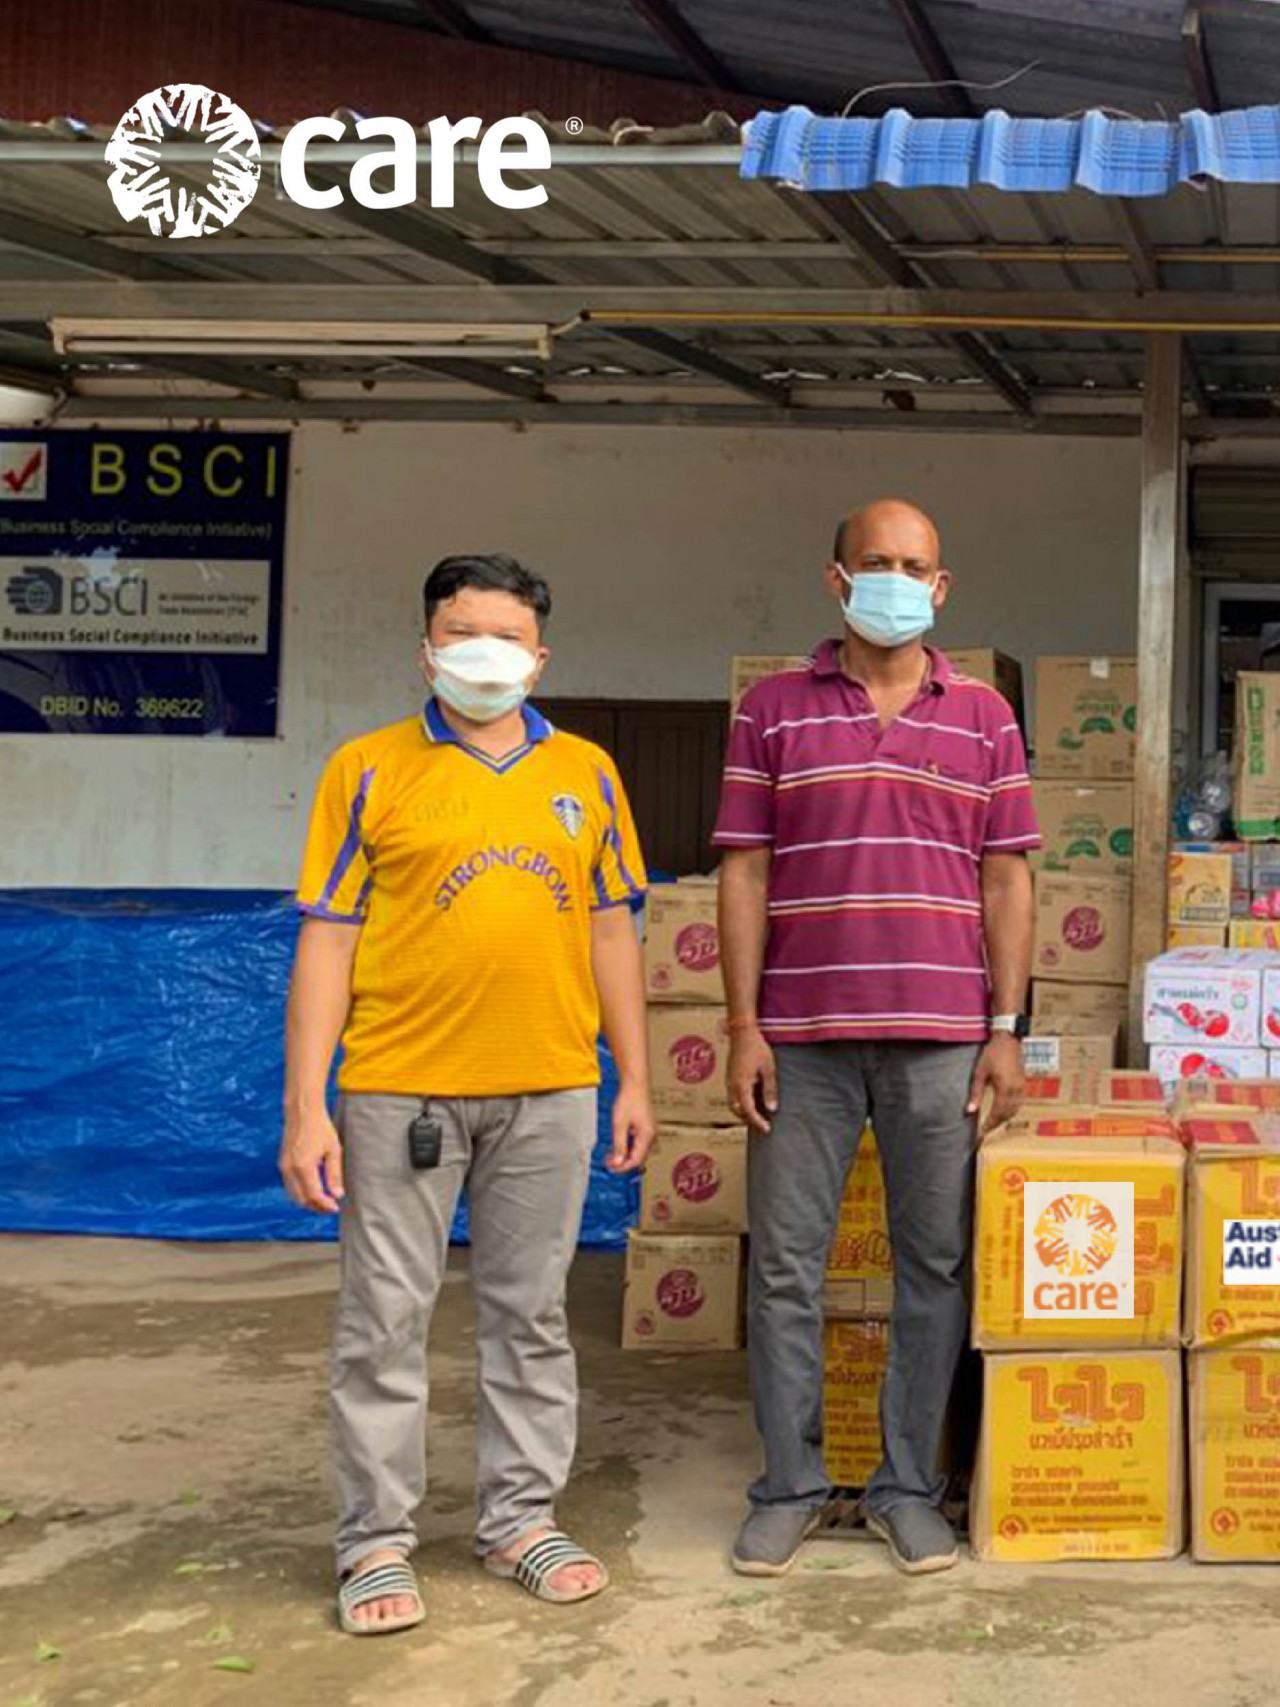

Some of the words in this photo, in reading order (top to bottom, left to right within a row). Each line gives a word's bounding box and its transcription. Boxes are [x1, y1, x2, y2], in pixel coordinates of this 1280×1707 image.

[70, 577, 148, 616] BSCI
[3, 626, 65, 643] Business
[70, 627, 110, 643] Social
[114, 628, 192, 646] Compliance
[196, 629, 259, 645] Initiative
[40, 695, 87, 715] DBID
[93, 696, 125, 717] No.
[135, 697, 204, 718] 369622
[434, 844, 572, 911] STRONGBOW
[1225, 1246, 1272, 1269] Aid
[1033, 1281, 1119, 1311] care
